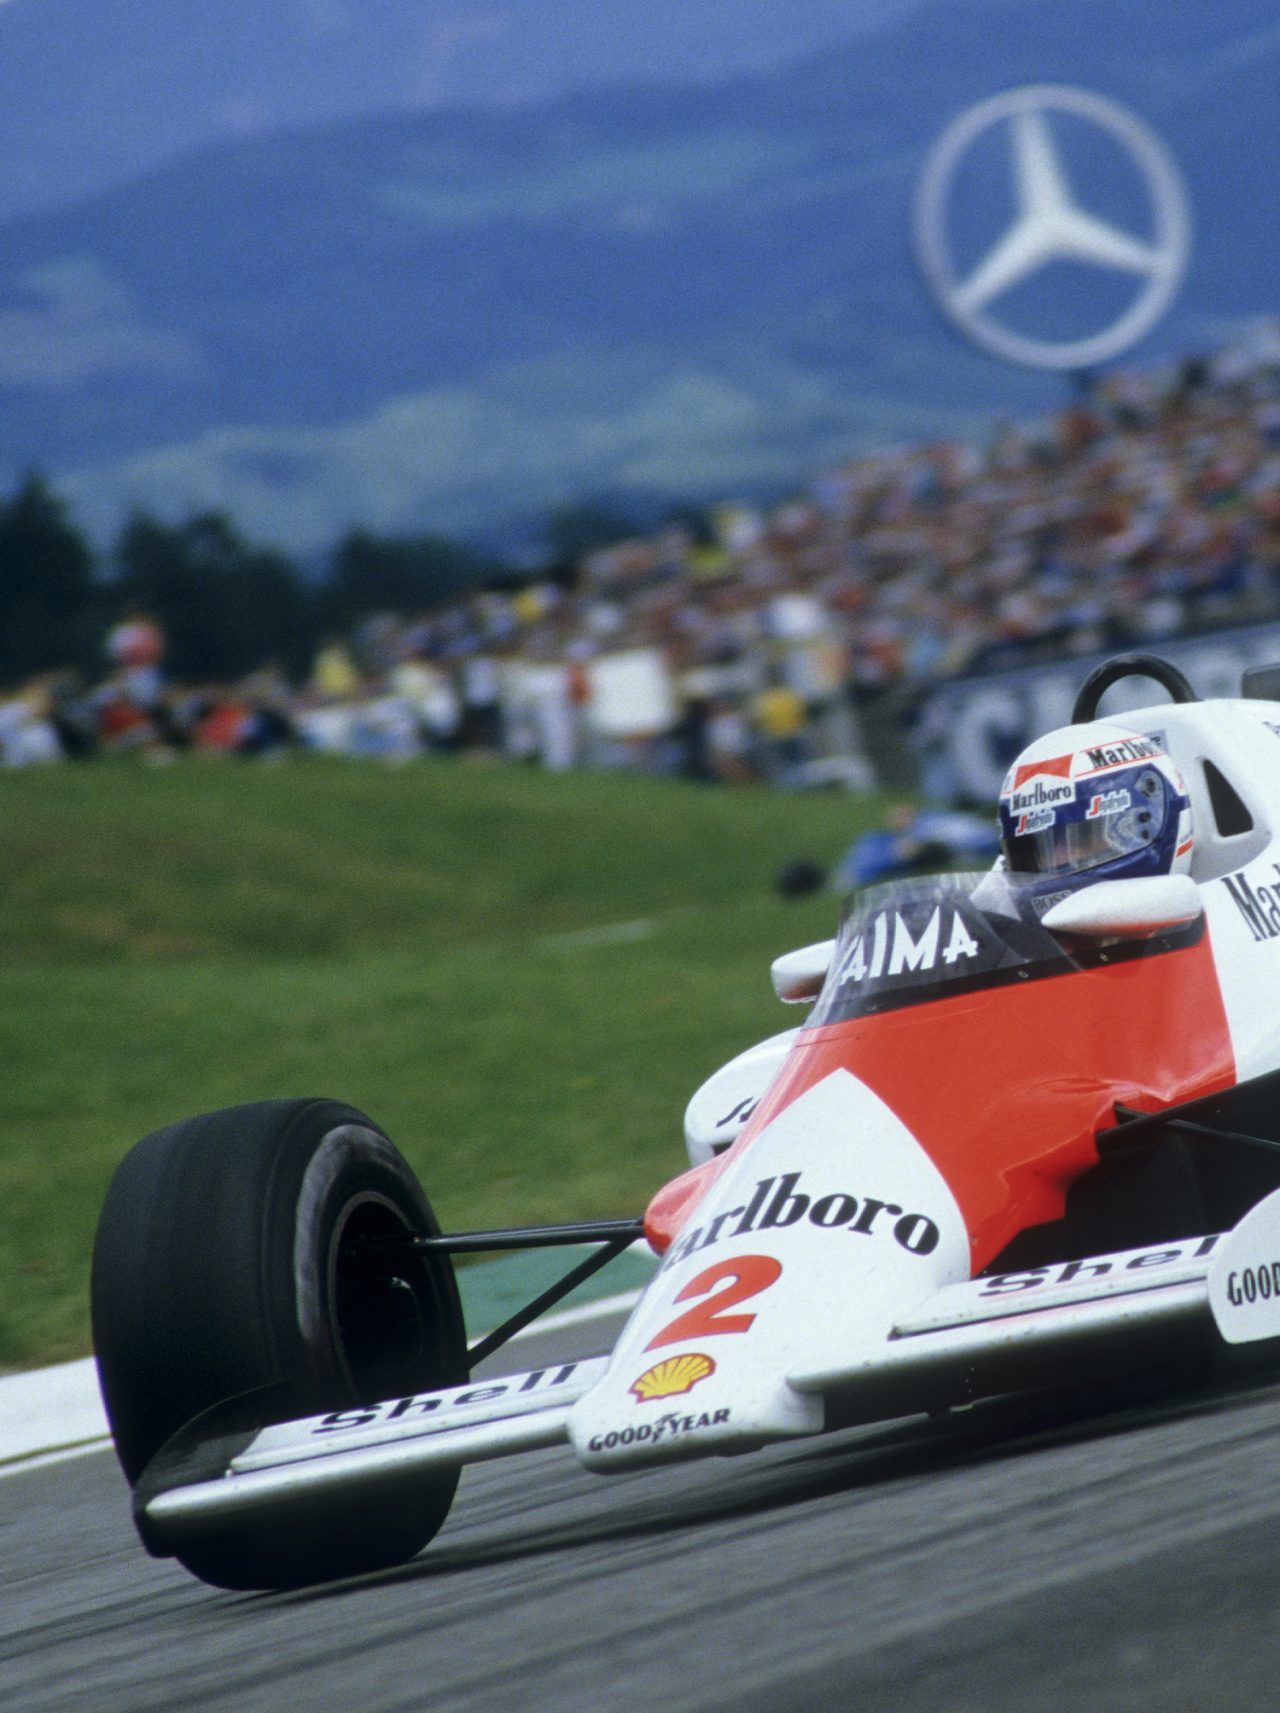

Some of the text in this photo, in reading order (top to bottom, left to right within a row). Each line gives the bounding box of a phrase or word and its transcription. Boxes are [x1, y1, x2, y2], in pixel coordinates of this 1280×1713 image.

[1012, 782, 1072, 811] Marlboro
[838, 905, 979, 987] AIMA
[643, 1254, 783, 1351] 2
[311, 1364, 578, 1434] Shell
